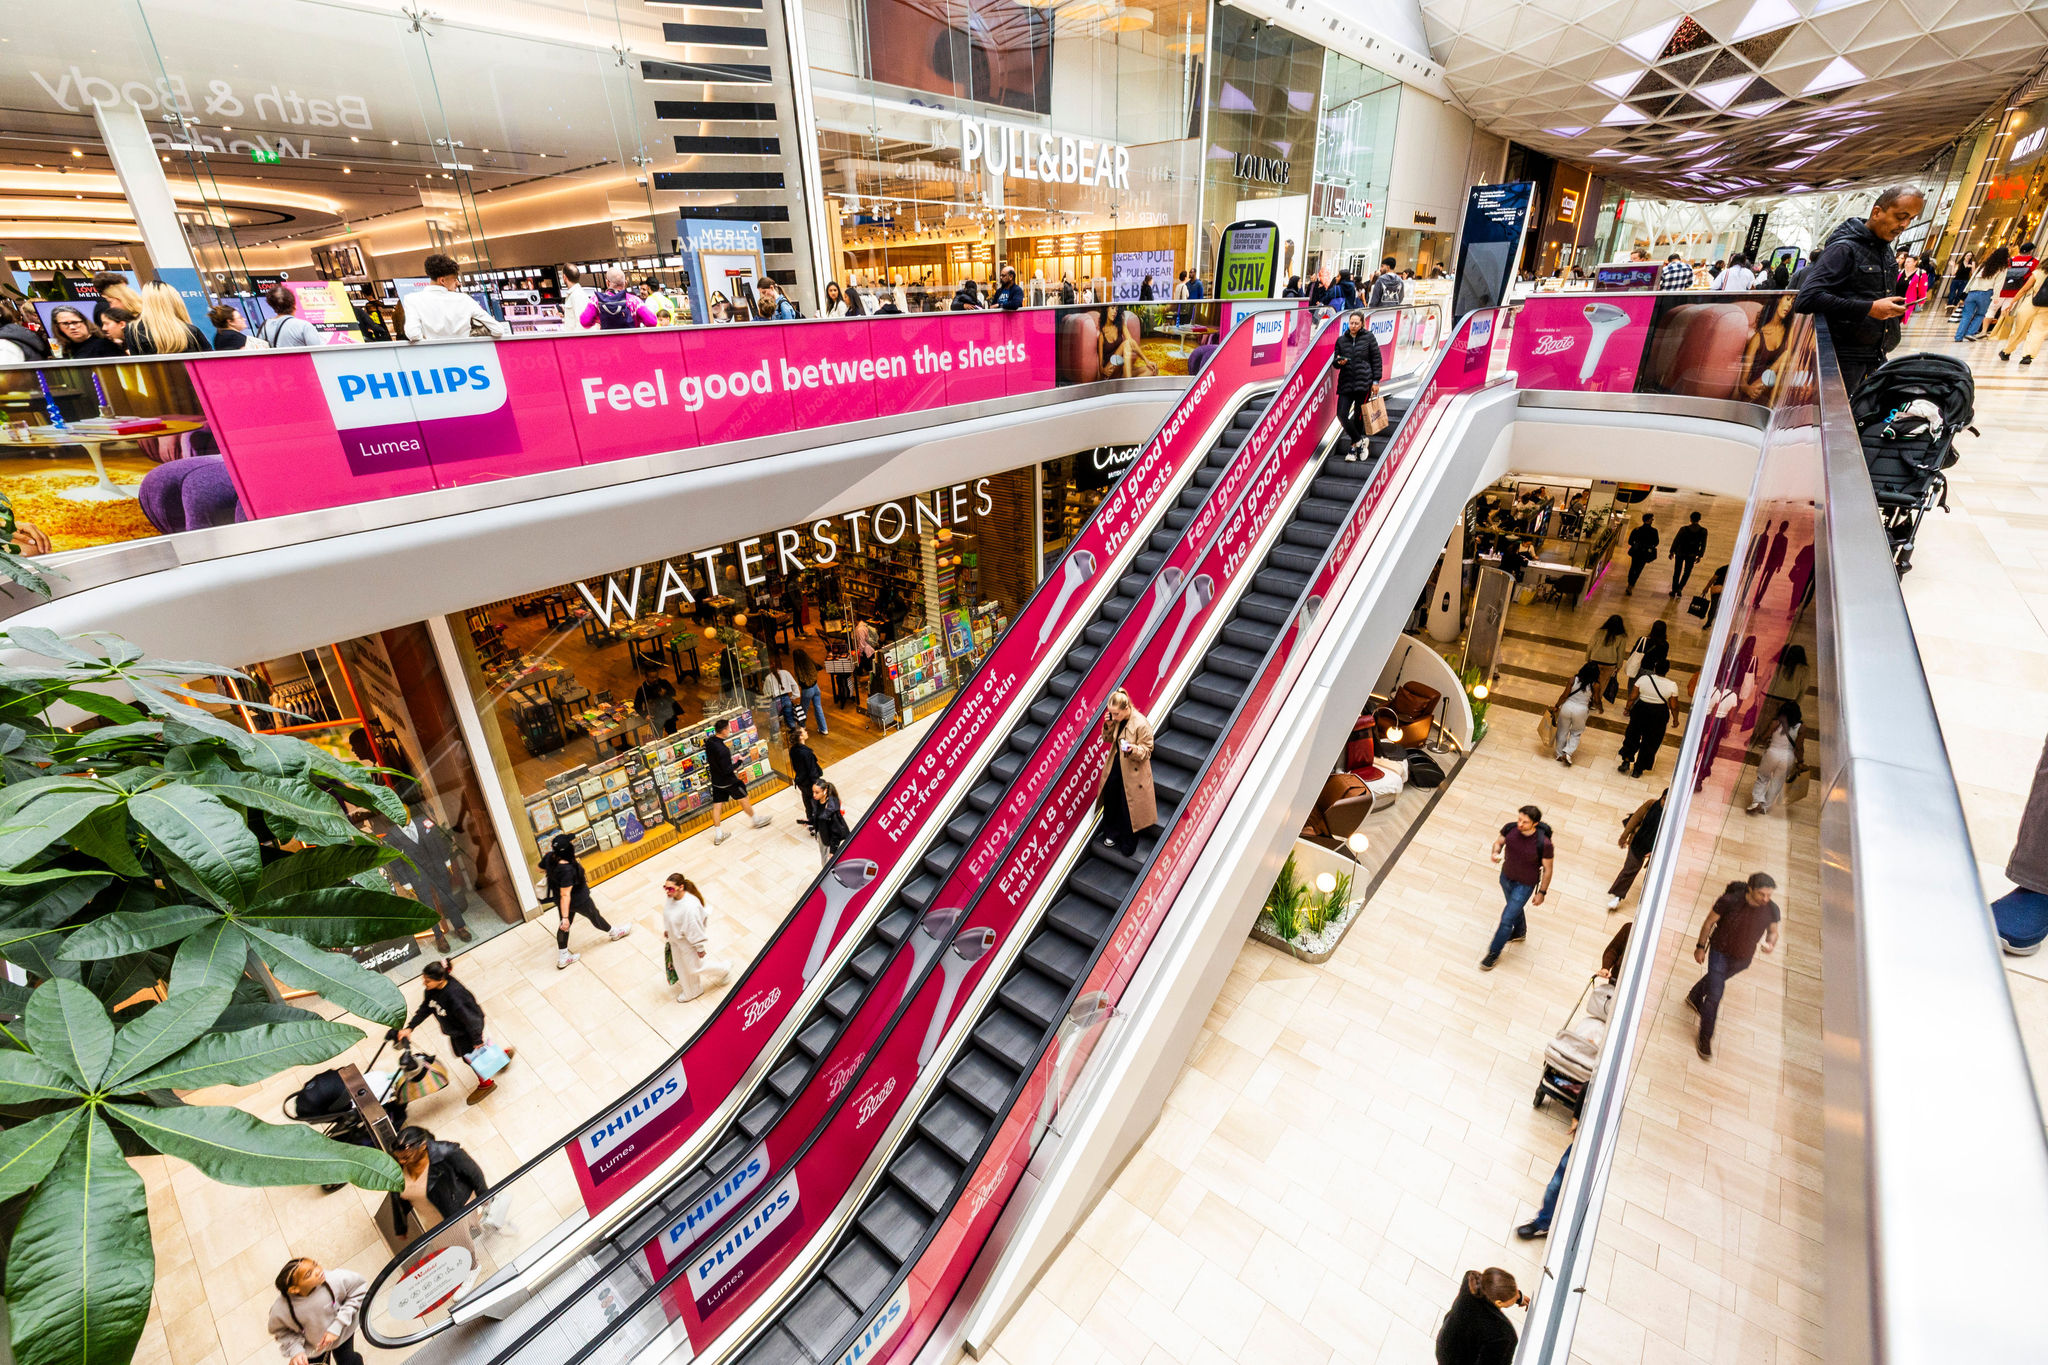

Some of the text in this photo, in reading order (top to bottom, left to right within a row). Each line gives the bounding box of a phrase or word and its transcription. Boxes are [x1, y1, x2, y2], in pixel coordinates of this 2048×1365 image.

[960, 118, 1129, 190] PULL&BEAR
[1233, 151, 1290, 185] LOUNGE
[701, 228, 749, 240] MERIT
[1333, 197, 1367, 218] swatch
[18, 259, 105, 271] BEAUTY HUB
[1113, 282, 1171, 299] L&BAR
[1127, 267, 1171, 278] PULL&BEAR
[1227, 263, 1265, 292] STAY.
[1256, 320, 1282, 334] PHILIPS
[1371, 319, 1393, 334] PHILIPS
[1471, 319, 1491, 336] PHILIPS
[1532, 335, 1575, 356] Boots
[337, 365, 491, 402] PHILIPS
[581, 338, 1026, 414] Feel good between the sheets
[359, 437, 421, 457] Lumea
[1096, 370, 1216, 535] Feel good between
[1186, 373, 1304, 550] Feel good between
[1217, 376, 1333, 556] Feel good between
[1328, 379, 1438, 575] Feel good between
[1104, 460, 1173, 556] the sheets
[1222, 474, 1288, 580] the sheets
[575, 478, 993, 628] WATERSTONES
[877, 668, 999, 831] Enjoy 18 months of
[888, 671, 1017, 843] hair-free smooth skin
[968, 696, 1089, 875] Enjoy 18 months of
[999, 734, 1104, 894] Enjoy 18 months
[1007, 749, 1111, 906] hair-free smooth
[1113, 743, 1234, 954] Enjoy 18 months of
[1121, 872, 1180, 966] hair-free
[737, 992, 758, 1010] Available
[742, 987, 781, 1031] Boots
[822, 1060, 844, 1079] Available
[827, 1052, 866, 1102] Boots
[590, 1077, 678, 1149] PHILIPS
[852, 1088, 873, 1107] Available
[856, 1076, 896, 1129] Boots
[599, 1143, 636, 1174] Lumea
[669, 1158, 762, 1244] PHILIPS
[699, 1189, 791, 1281] PHILIPS
[706, 1268, 745, 1307] Lumea
[841, 1299, 901, 1365] ILIPS
